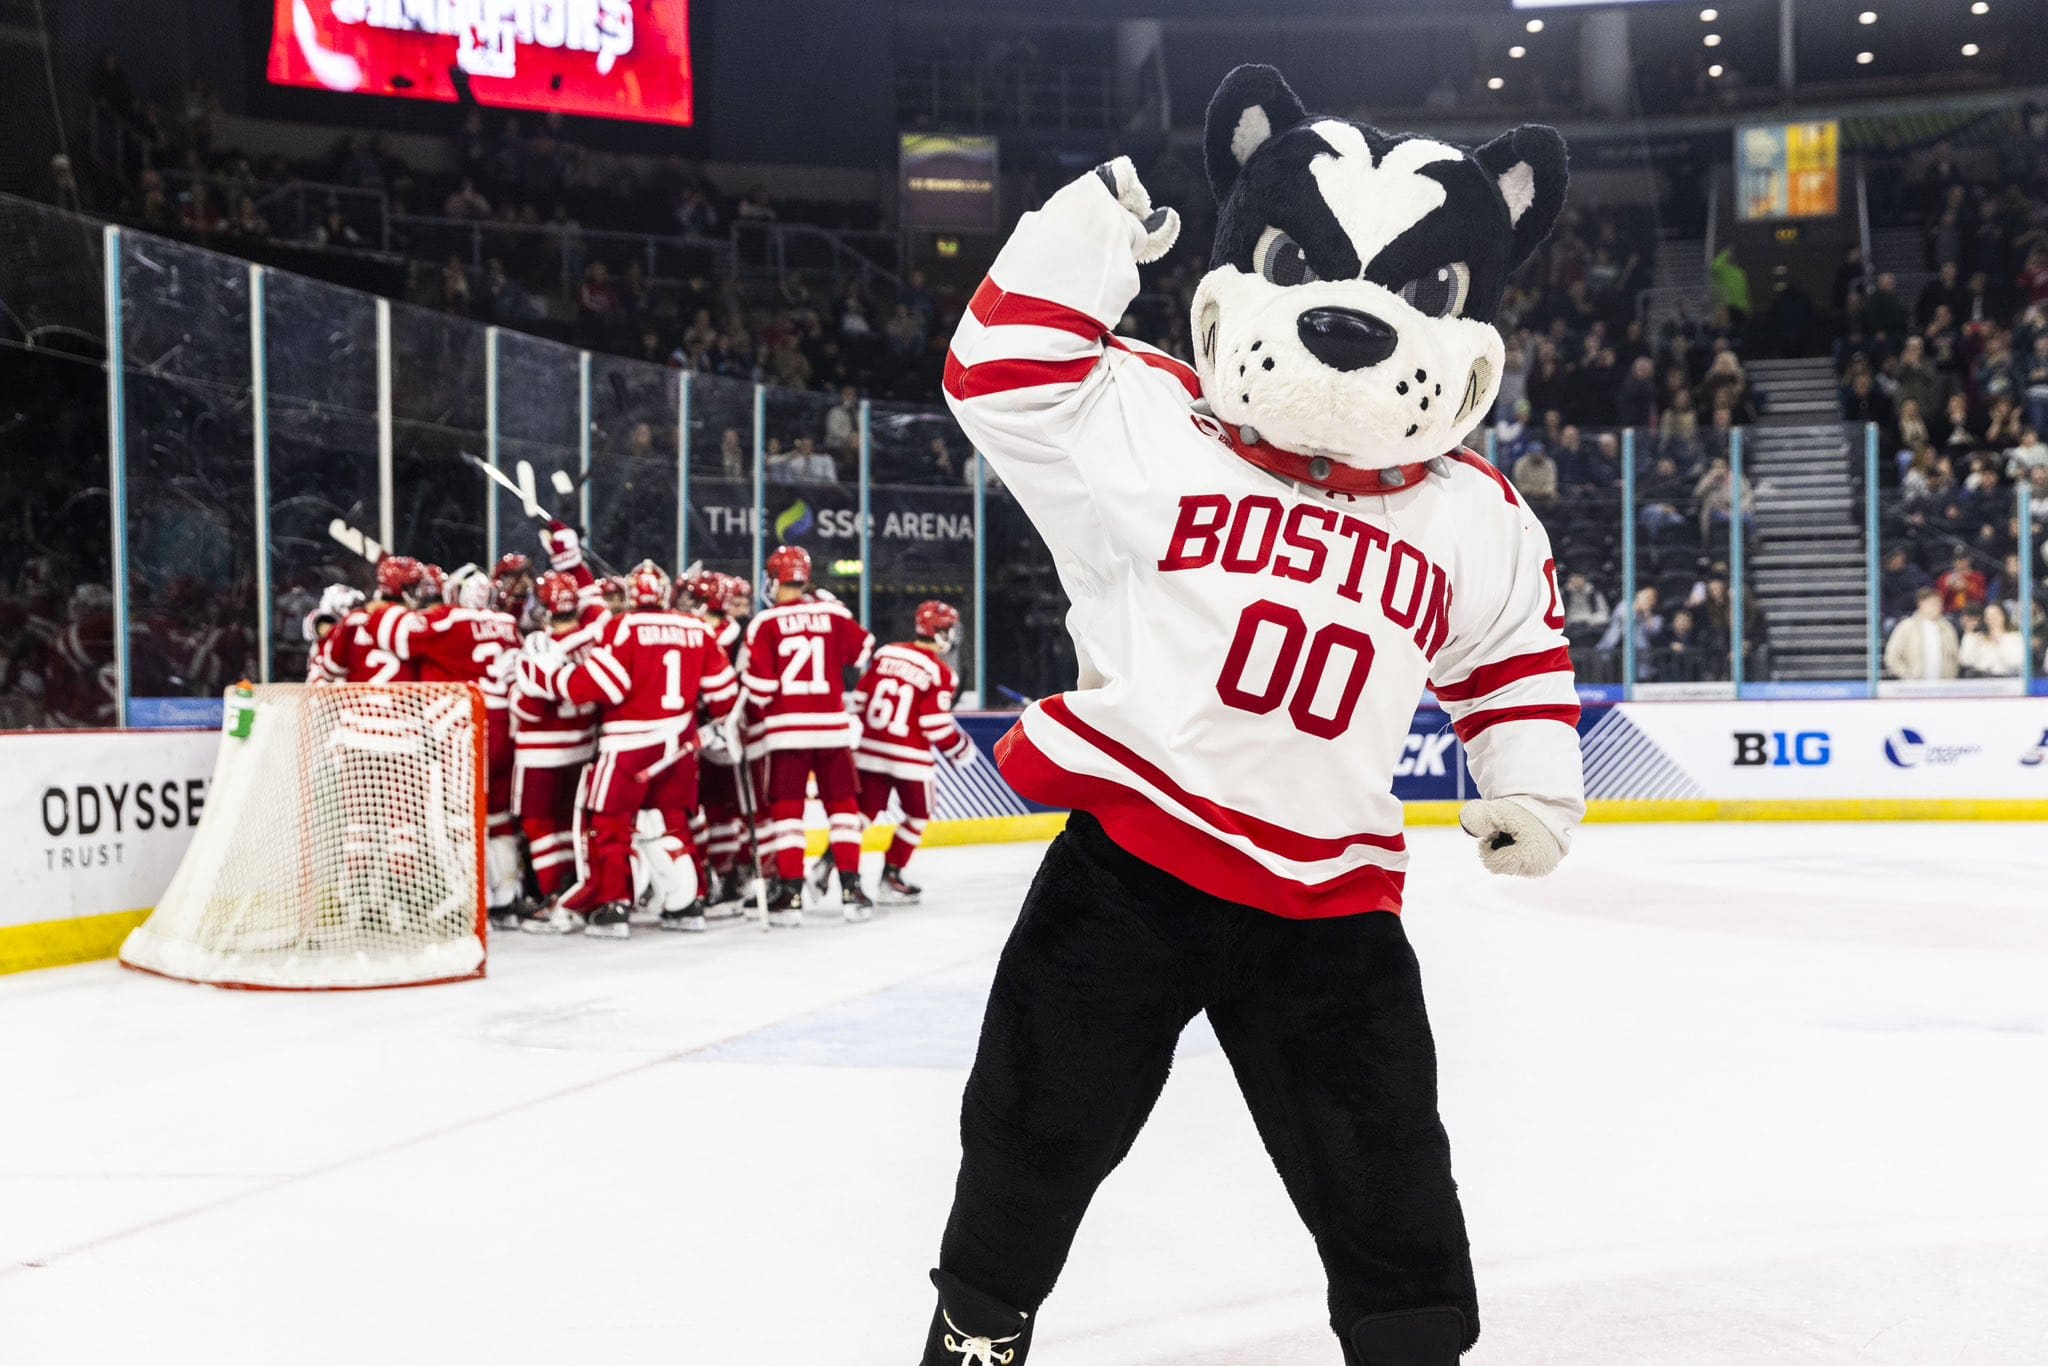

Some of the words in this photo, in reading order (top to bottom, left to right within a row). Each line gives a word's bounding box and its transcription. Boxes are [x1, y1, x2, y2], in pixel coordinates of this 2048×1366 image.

[882, 511, 974, 540] ARENA
[1157, 493, 1453, 663] BOSTON
[661, 649, 685, 711] 1
[778, 635, 831, 696] 21
[1216, 598, 1375, 741] 00
[866, 677, 914, 738] 61
[42, 777, 213, 837] ODYSSE
[45, 842, 124, 871] TRUST
